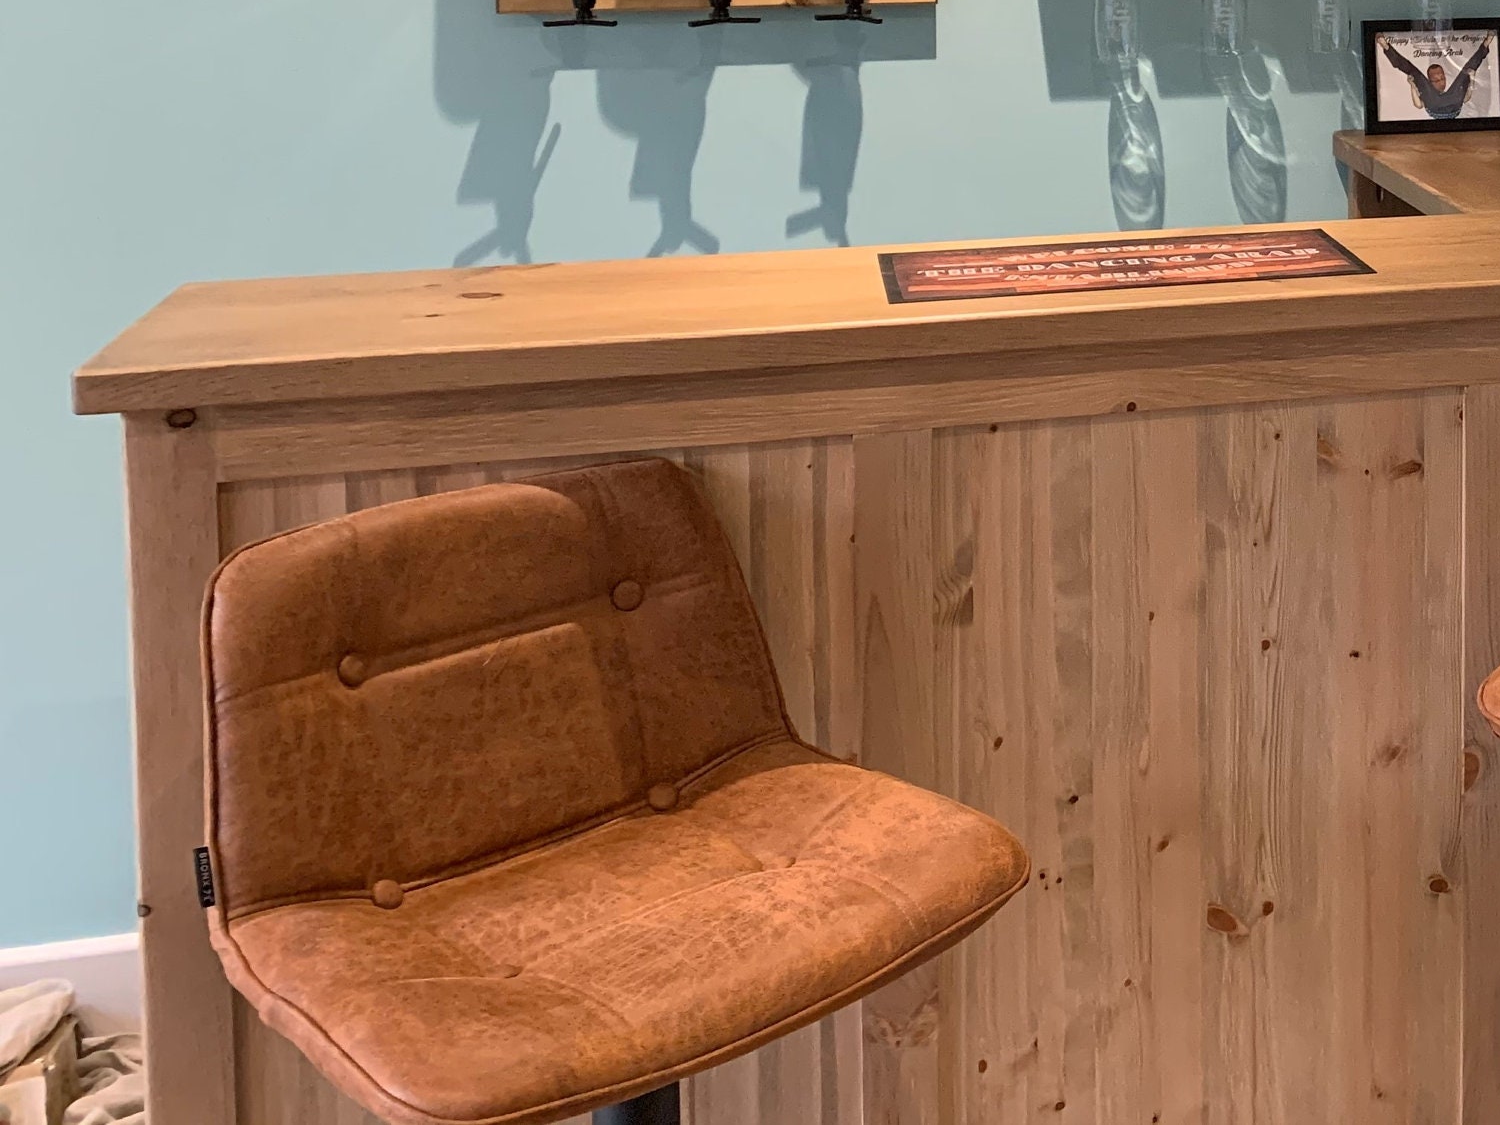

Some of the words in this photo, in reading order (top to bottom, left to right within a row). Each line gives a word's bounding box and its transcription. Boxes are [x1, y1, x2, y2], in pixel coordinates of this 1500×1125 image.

[917, 265, 1006, 277] THE
[1017, 254, 1197, 273] DANCING
[1208, 248, 1320, 261] ARAB
